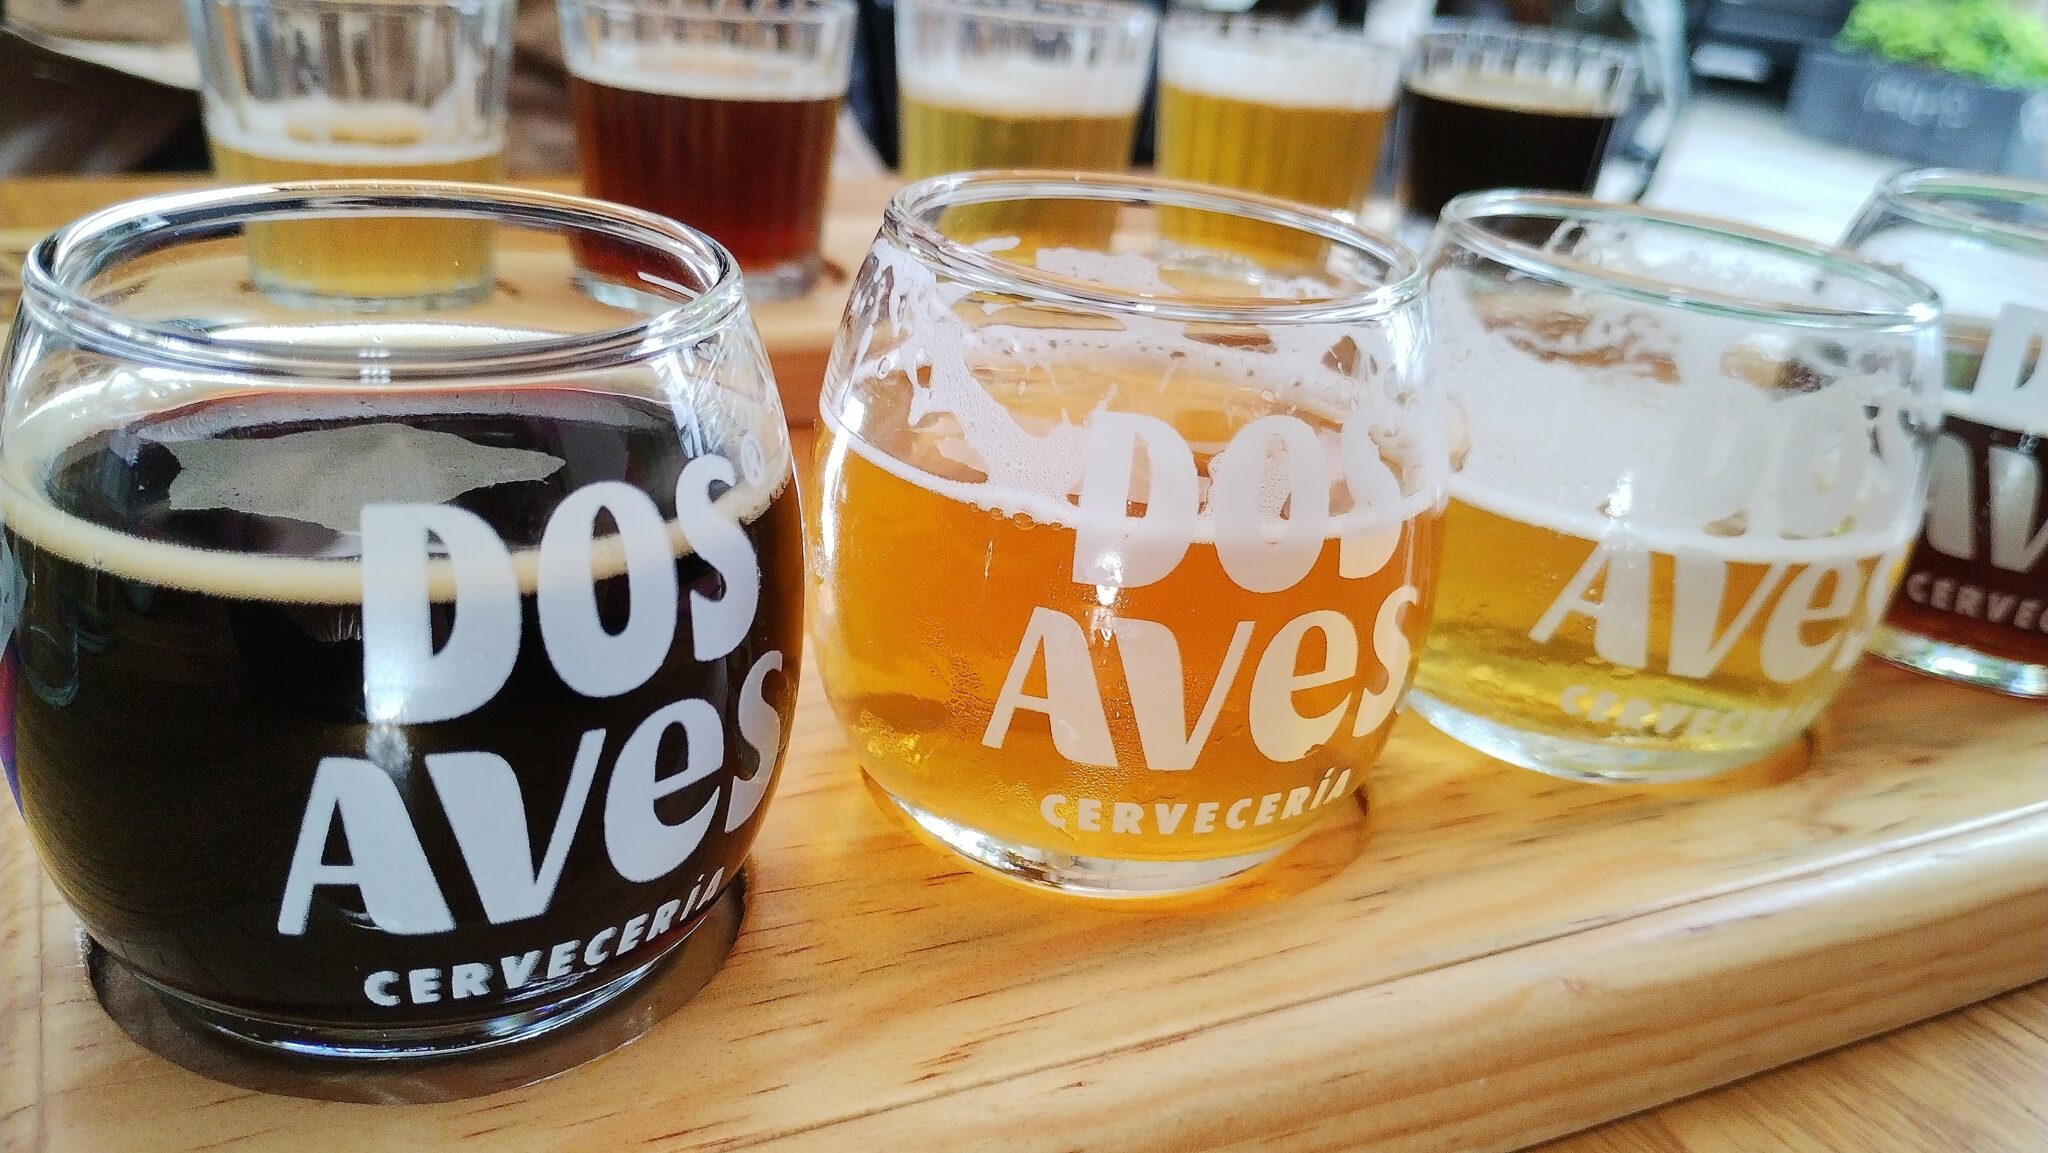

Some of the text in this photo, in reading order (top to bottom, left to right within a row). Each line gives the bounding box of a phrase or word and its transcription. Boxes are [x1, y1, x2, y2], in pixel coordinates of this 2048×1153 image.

[1072, 405, 1403, 593] DOS
[361, 454, 760, 724] DOS
[1906, 572, 2048, 633] CERVE
[1040, 768, 1352, 835] CERVECERÍA
[363, 866, 725, 1007] CERVECERÍA
